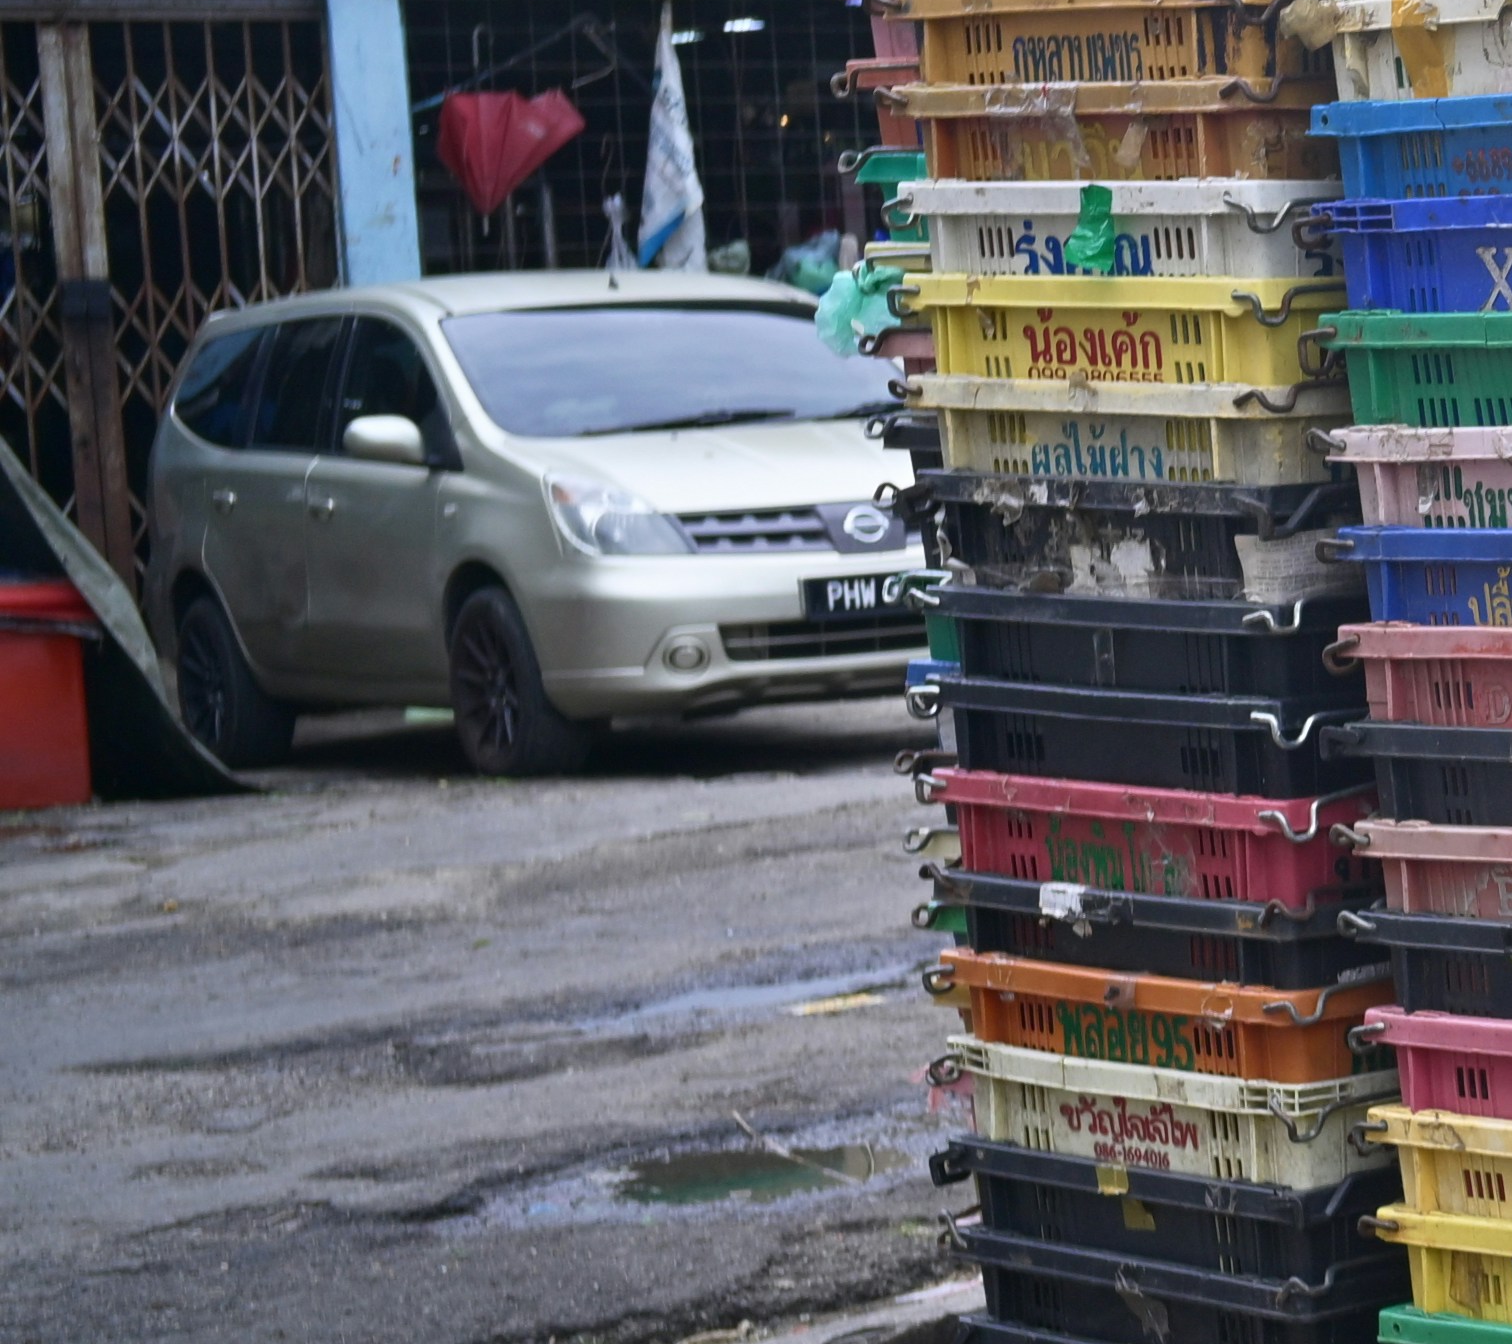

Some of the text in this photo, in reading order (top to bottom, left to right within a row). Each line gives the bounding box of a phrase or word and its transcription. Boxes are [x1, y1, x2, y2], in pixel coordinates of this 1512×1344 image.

[1022, 308, 1163, 371] น้องเค้ก
[1056, 999, 1196, 1071] พลอย 95
